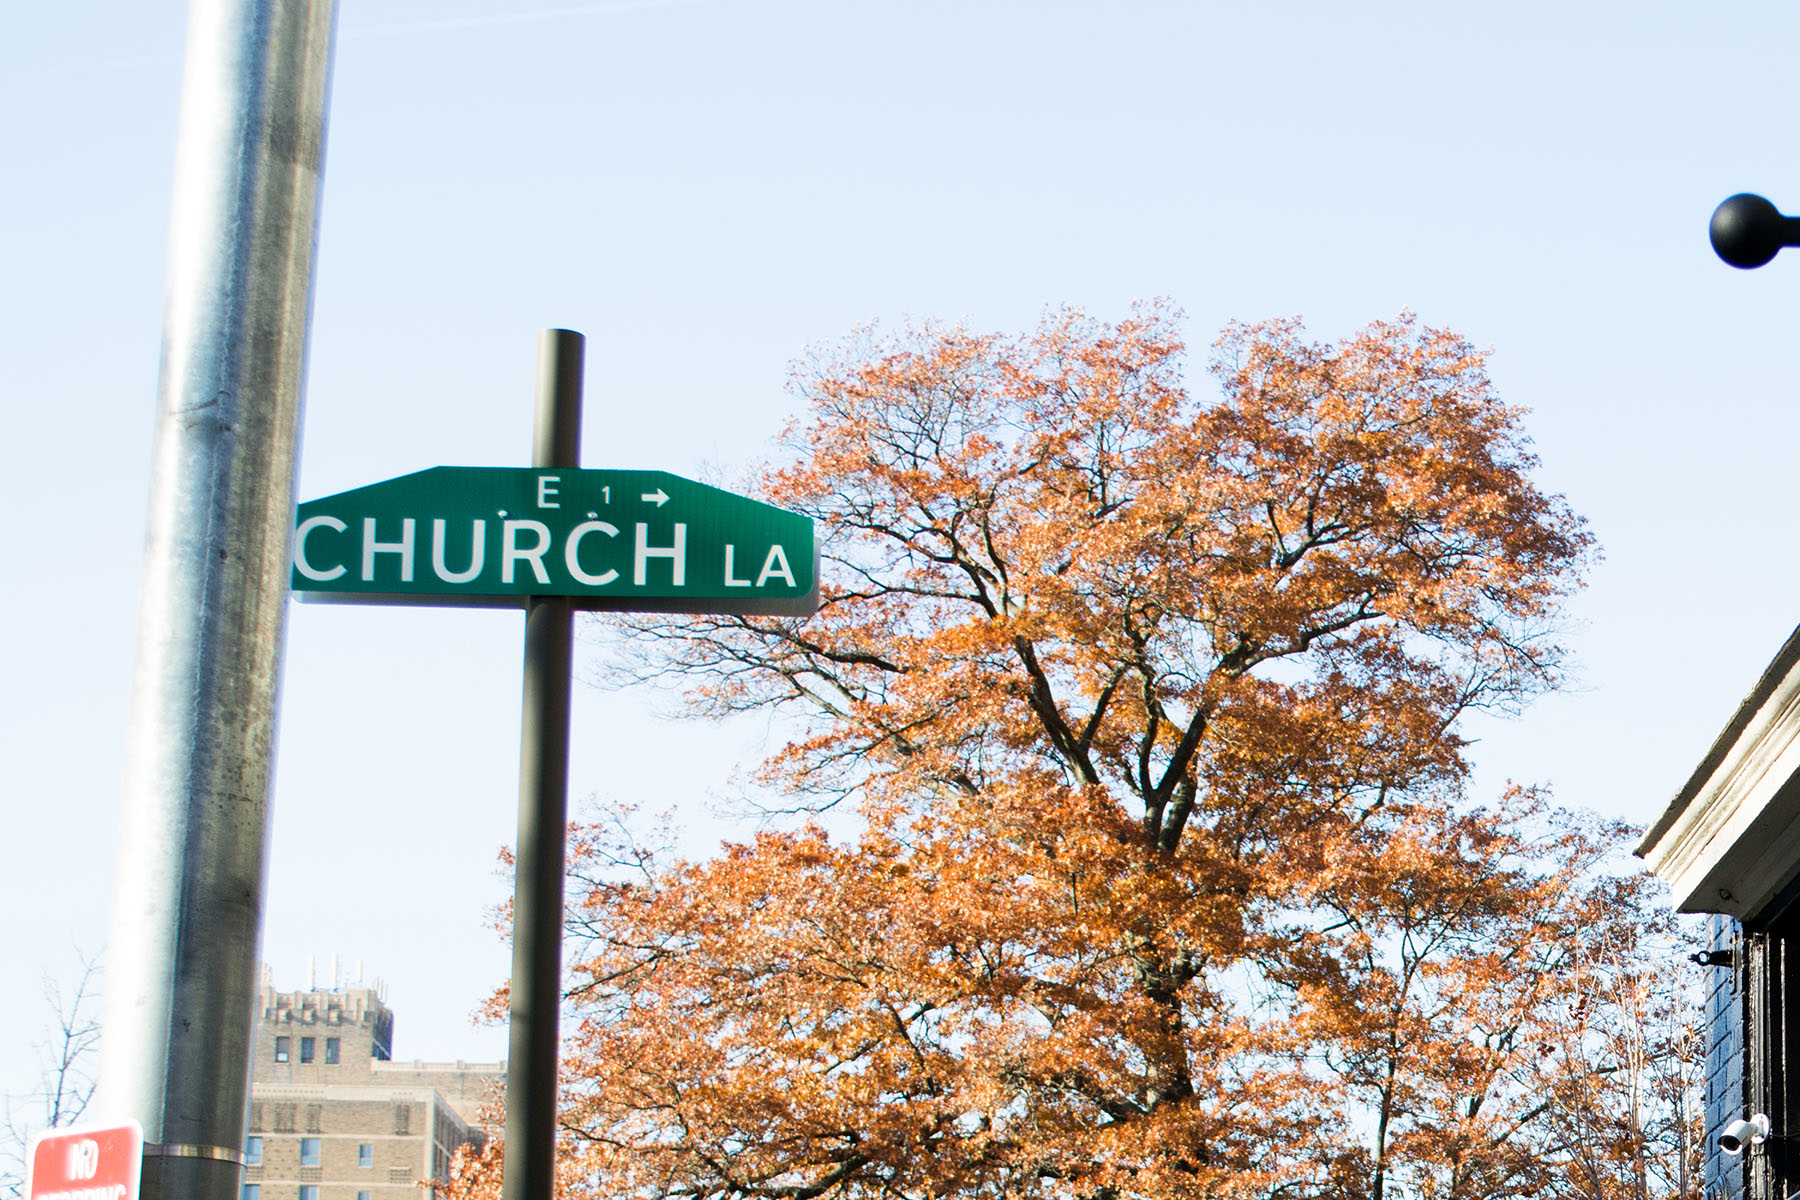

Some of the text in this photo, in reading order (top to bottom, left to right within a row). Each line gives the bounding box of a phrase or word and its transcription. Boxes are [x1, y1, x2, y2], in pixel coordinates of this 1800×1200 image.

[538, 475, 611, 509] E 1
[294, 515, 796, 588] CHURCH LA
[67, 1139, 99, 1181] NO
